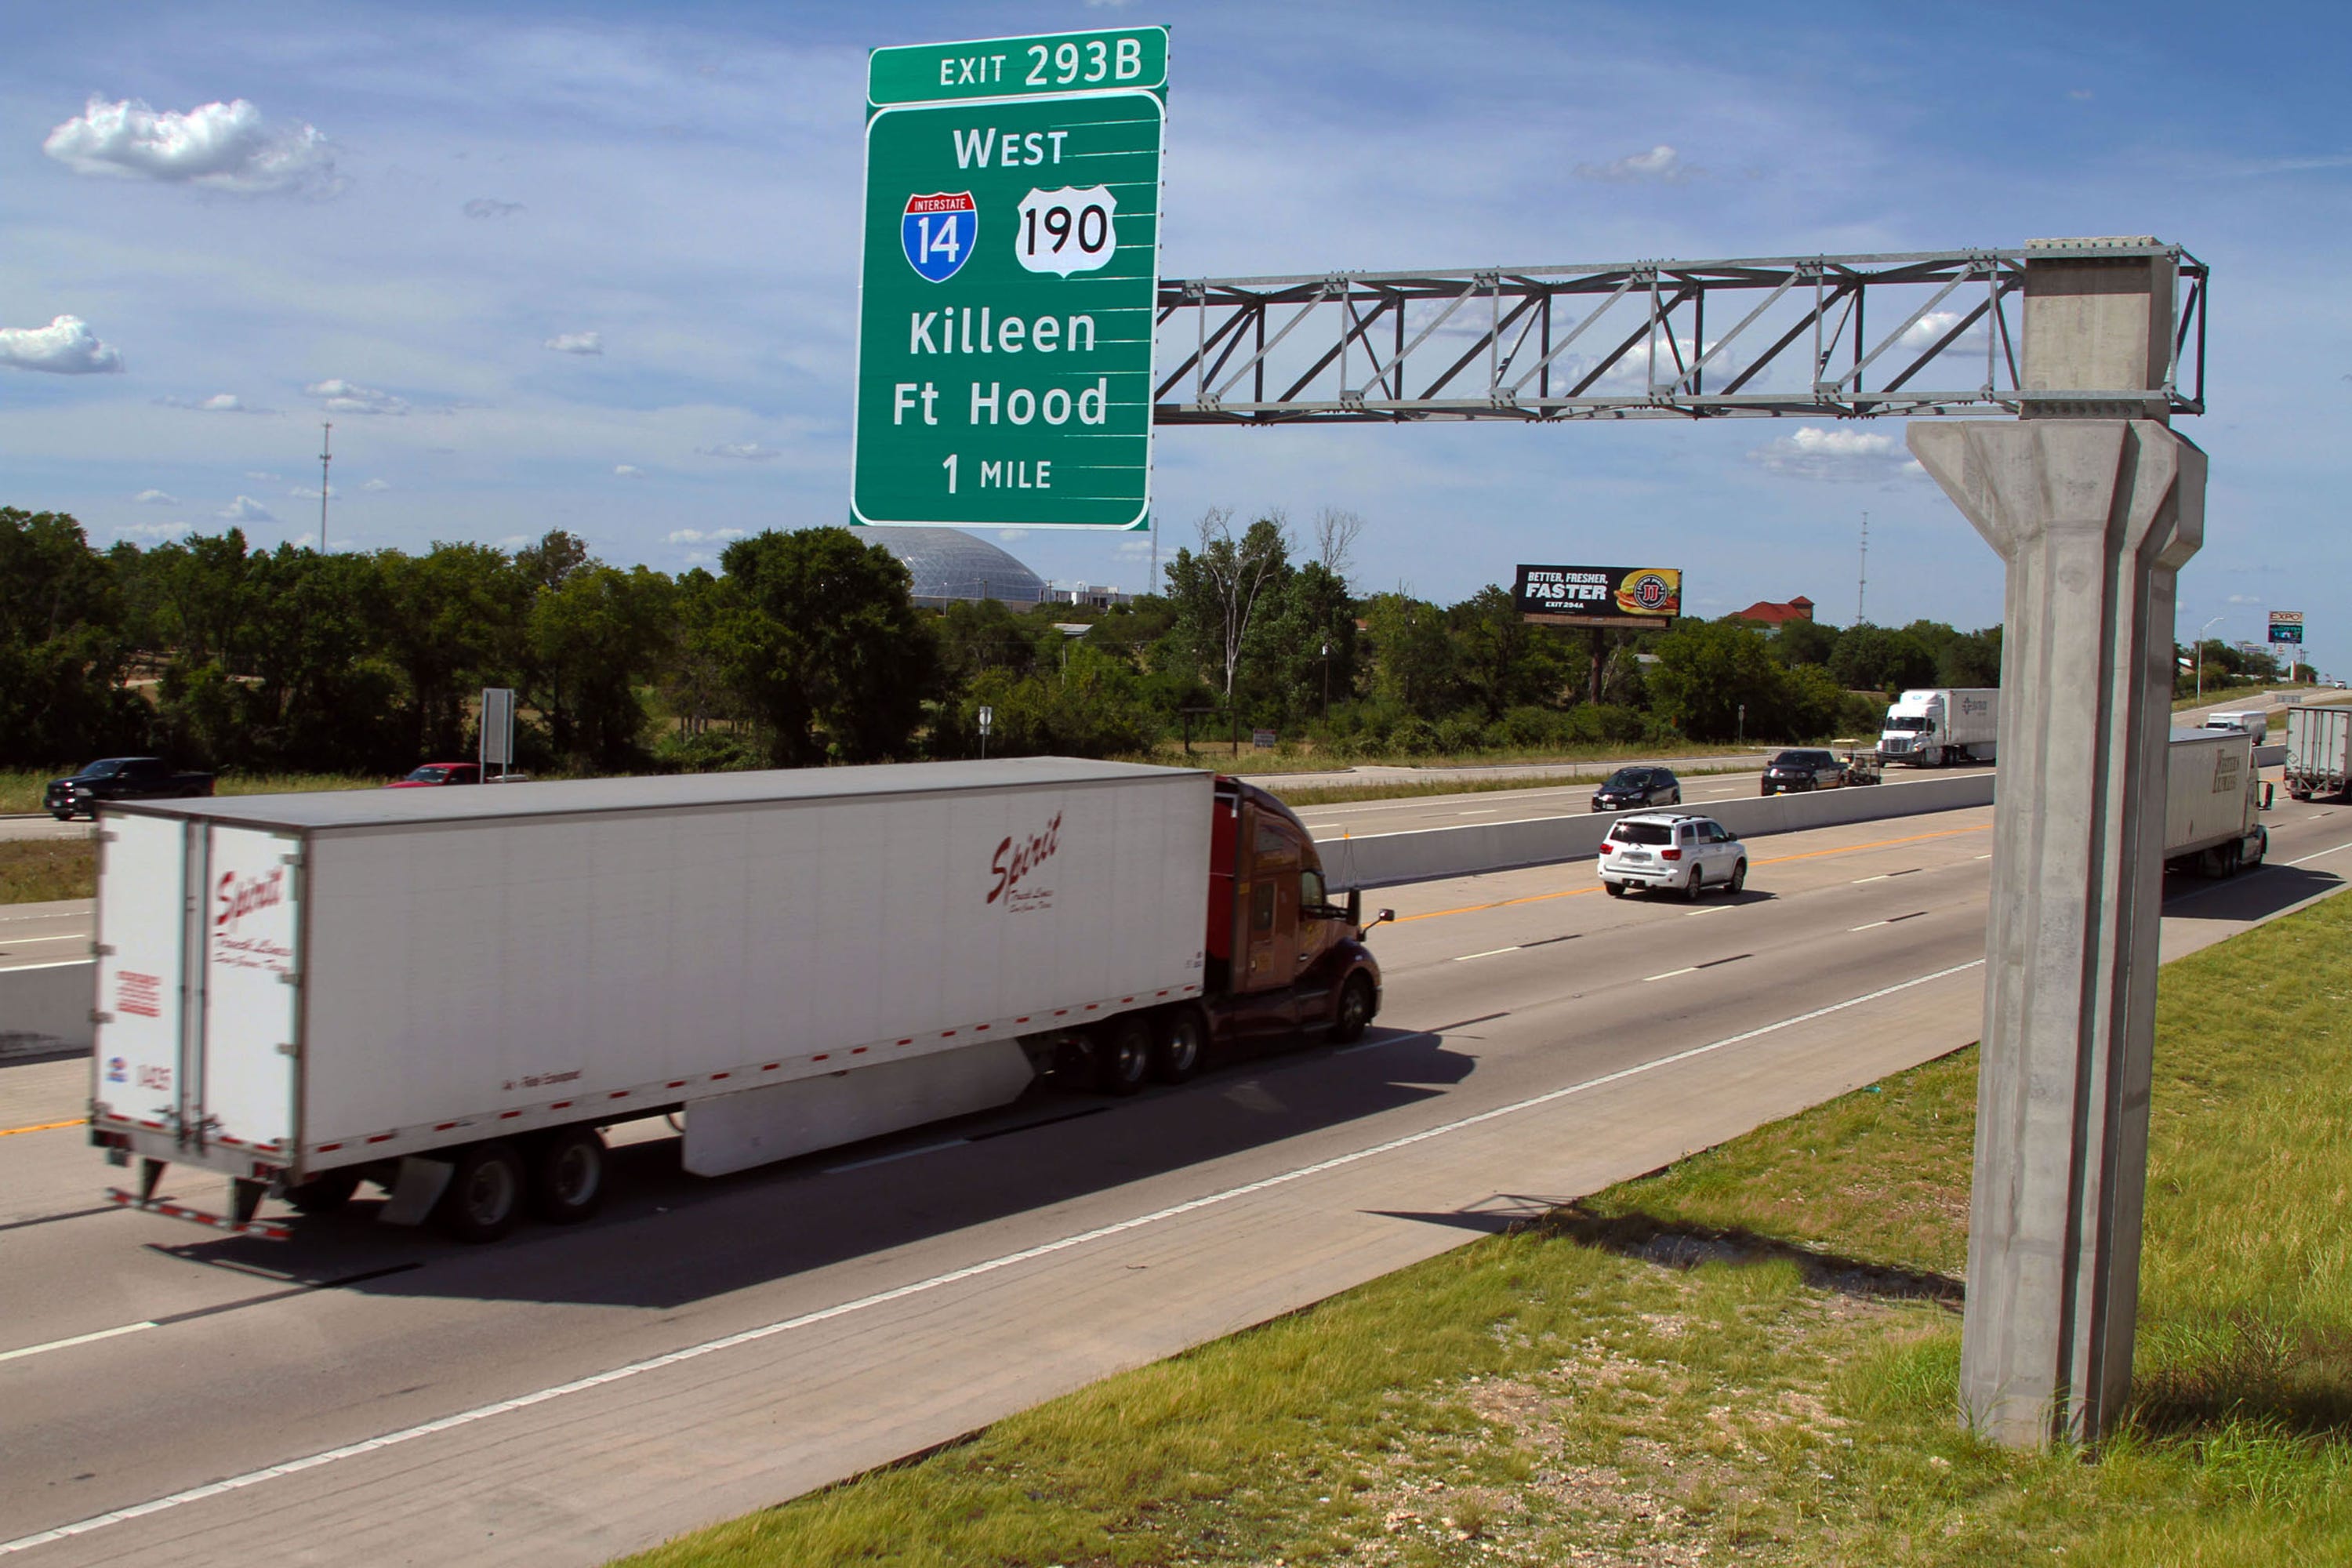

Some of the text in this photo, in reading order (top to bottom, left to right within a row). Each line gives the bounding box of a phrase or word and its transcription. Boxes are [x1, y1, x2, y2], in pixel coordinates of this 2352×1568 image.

[940, 38, 1142, 85] EXIT 293B
[953, 128, 1068, 169] WEST
[914, 198, 967, 212] INTERSTATE
[918, 215, 960, 264] 14
[1025, 205, 1107, 256] 190
[909, 307, 1095, 354] Killeen
[894, 377, 1107, 426] Ft Hood
[942, 454, 1051, 494] 1 MILE
[1525, 583, 1607, 600] FASTER
[1566, 573, 1609, 584] FRESHER,
[987, 811, 1062, 906] Spirit
